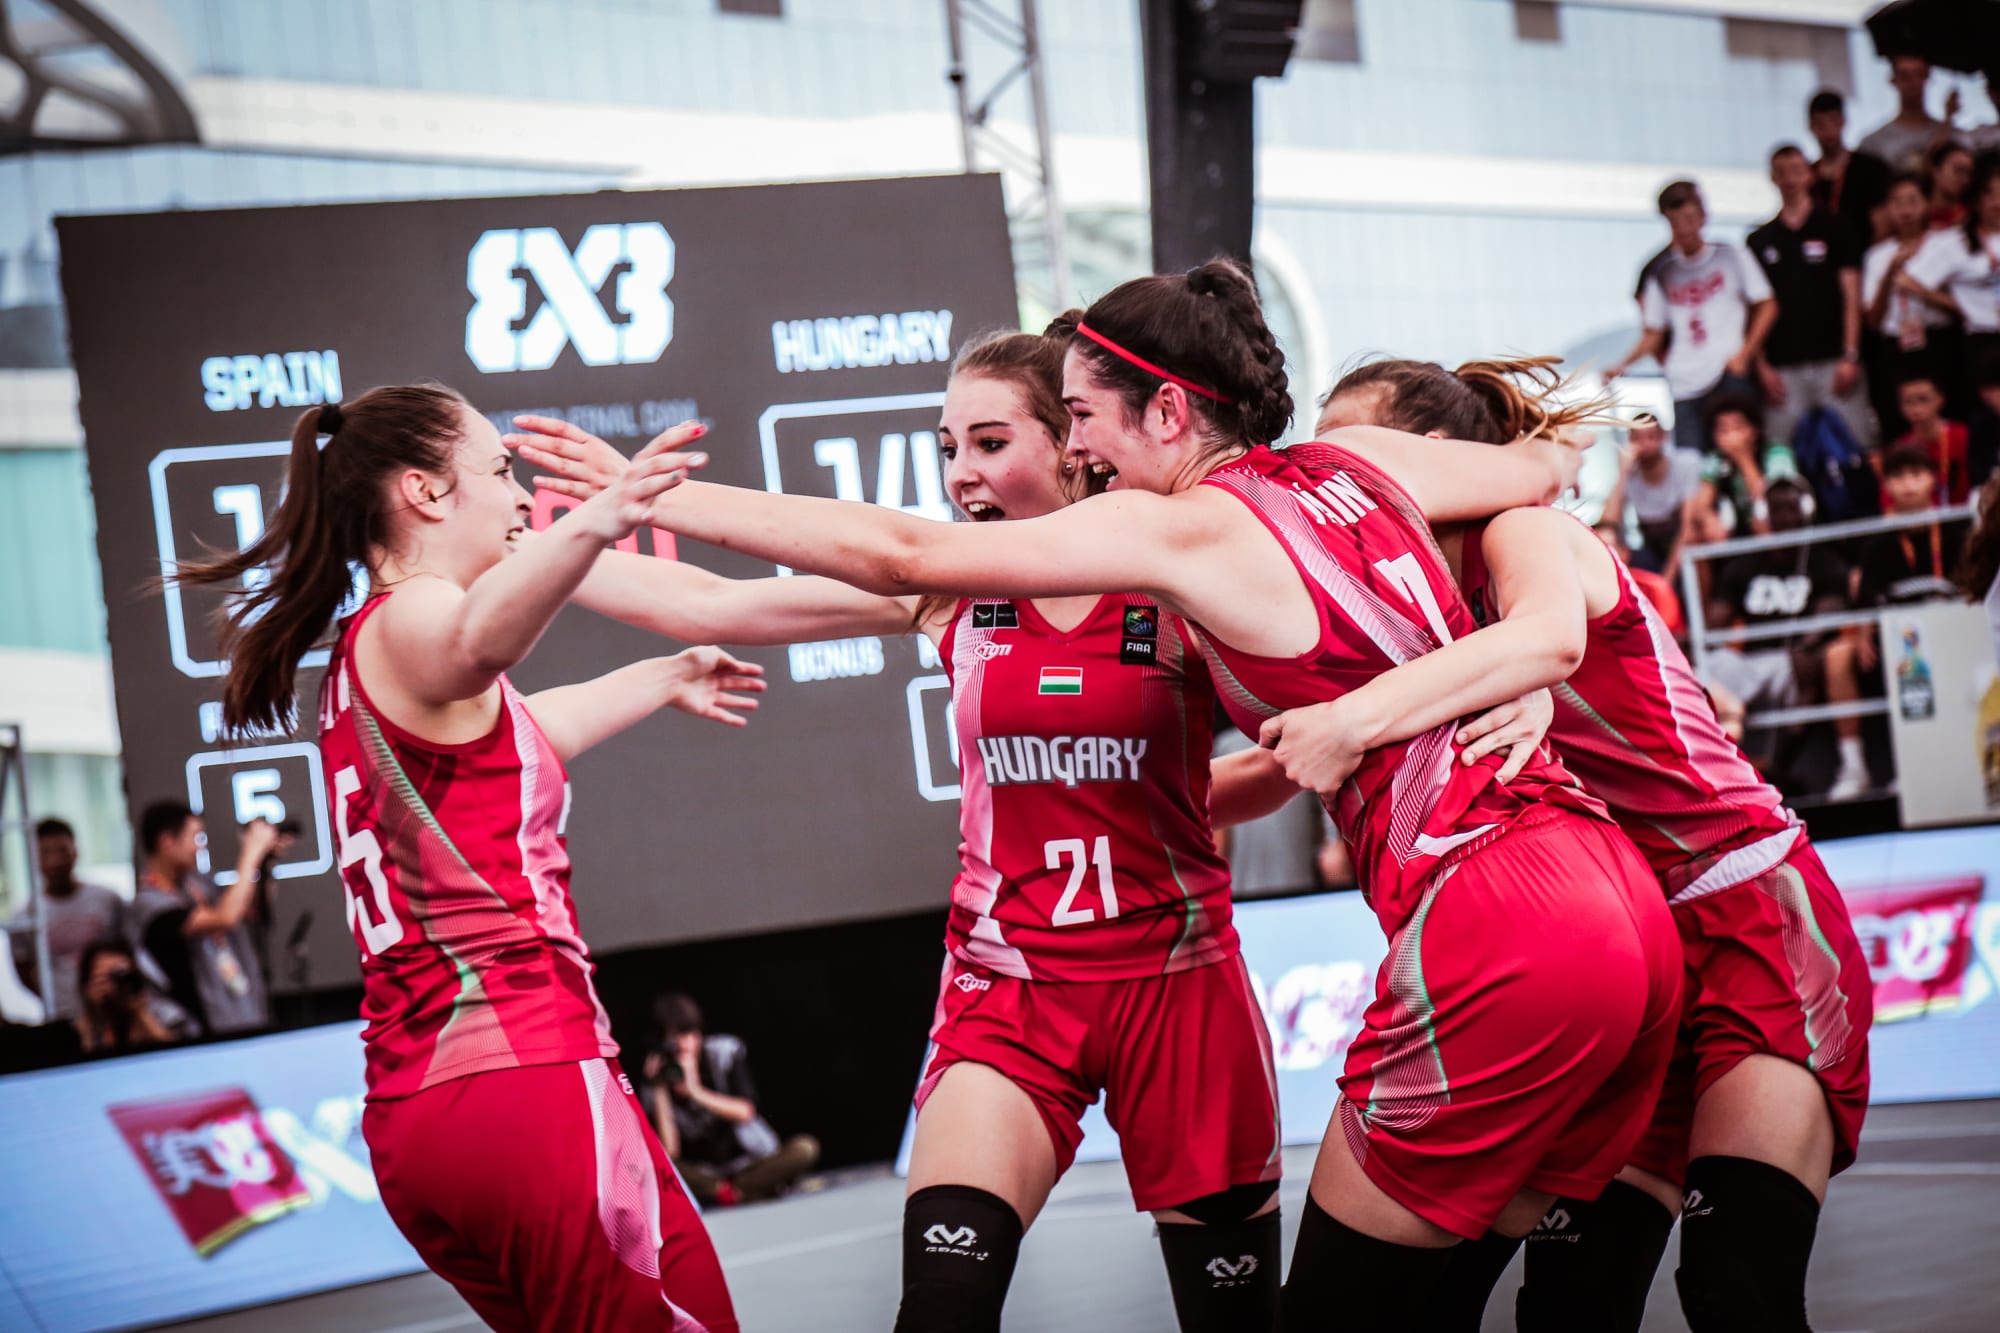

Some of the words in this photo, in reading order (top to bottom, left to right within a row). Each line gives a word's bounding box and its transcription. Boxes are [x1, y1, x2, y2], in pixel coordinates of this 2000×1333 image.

[772, 310, 953, 373] HUNGARY
[201, 350, 343, 412] SPAIN
[1126, 642, 1151, 655] FIBA
[976, 733, 1147, 788] HUNGARY
[232, 769, 286, 825] 5
[1044, 835, 1119, 927] 21
